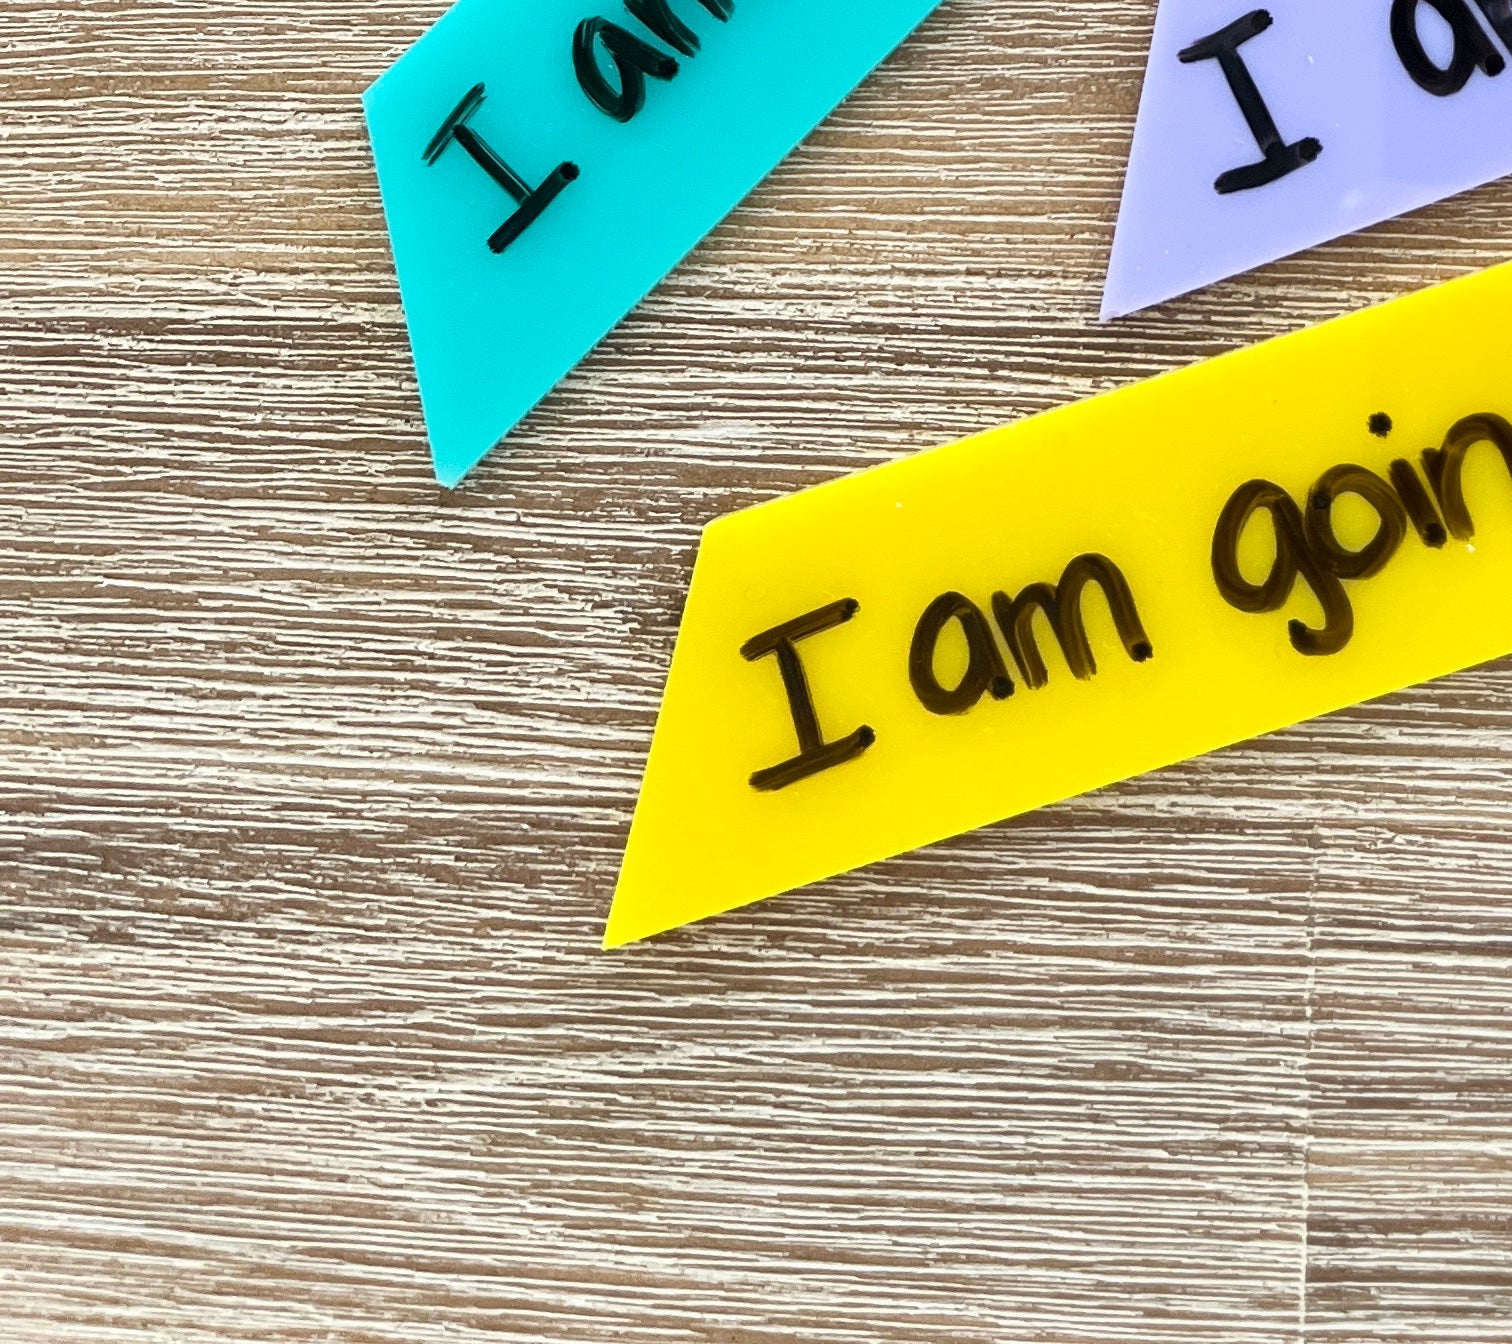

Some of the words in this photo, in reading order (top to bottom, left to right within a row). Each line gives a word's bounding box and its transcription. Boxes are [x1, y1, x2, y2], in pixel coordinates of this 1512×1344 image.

[422, 82, 580, 254] I
[1177, 9, 1323, 195] I
[740, 598, 875, 791] I
[909, 554, 1153, 715] am
